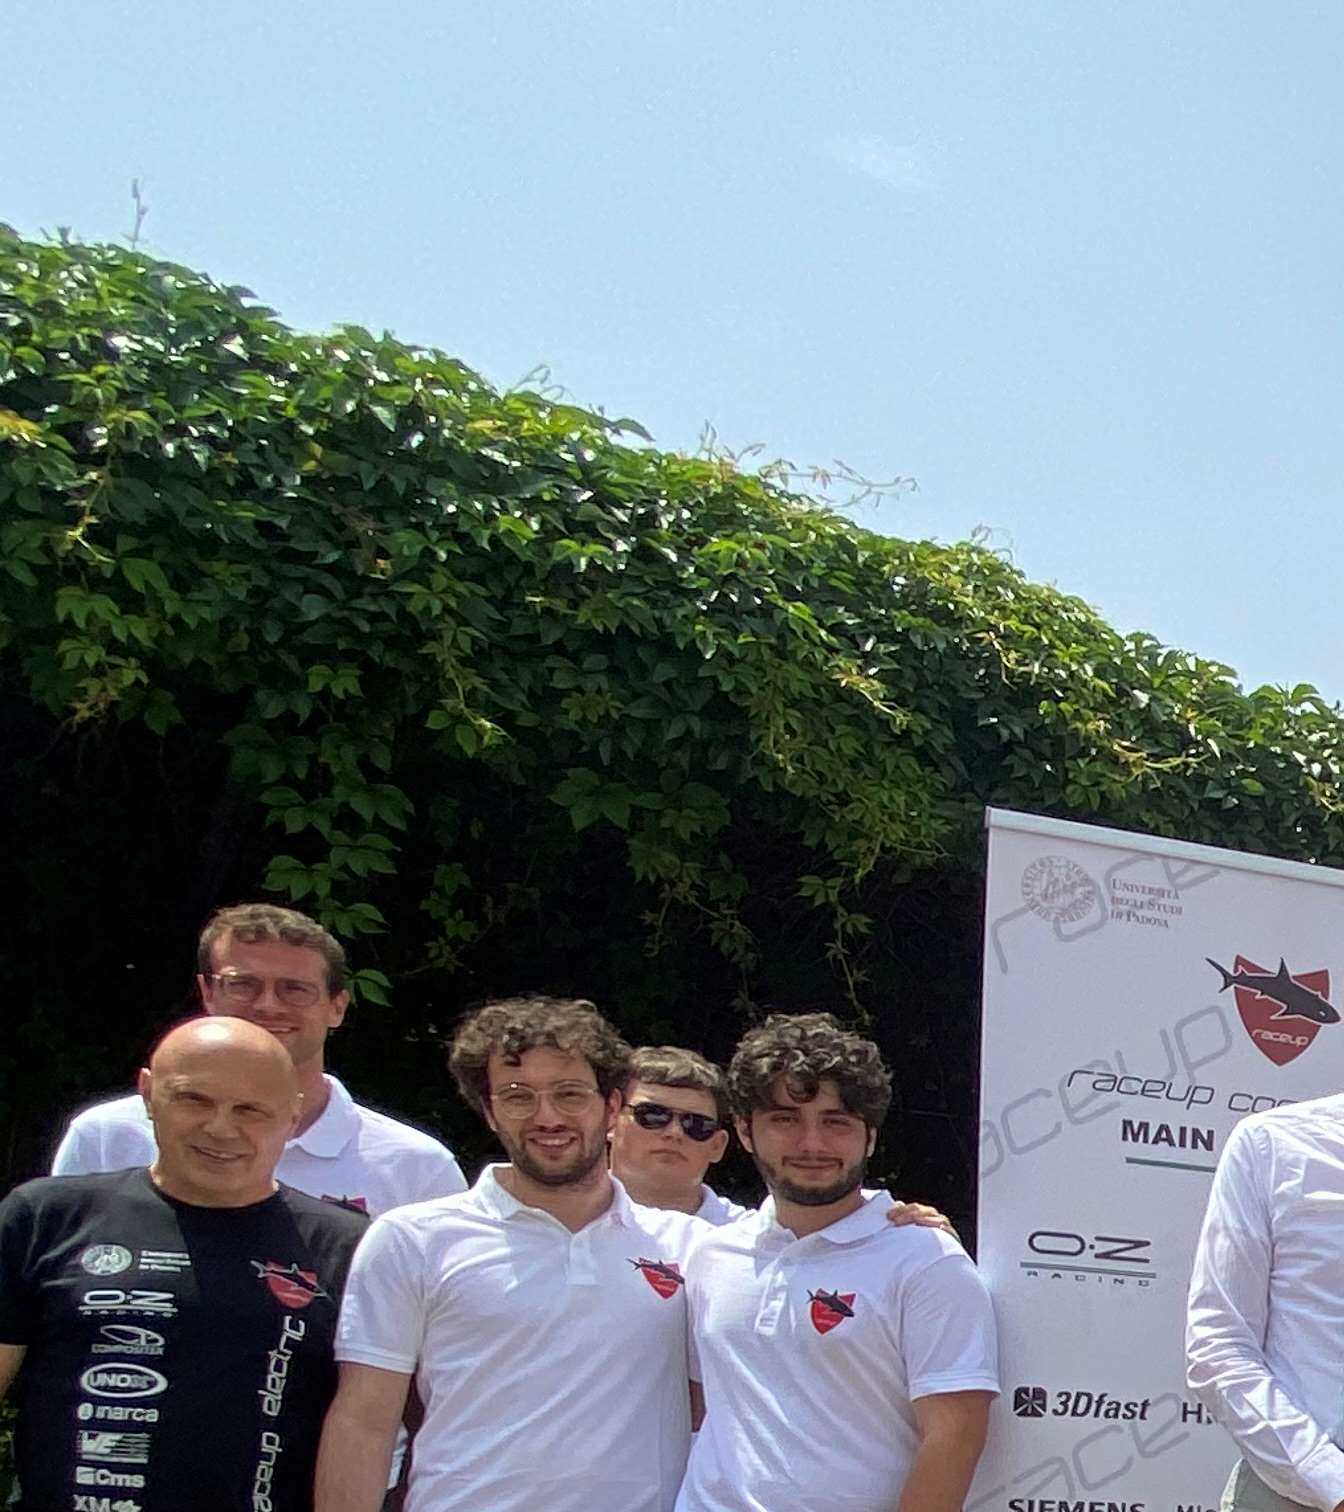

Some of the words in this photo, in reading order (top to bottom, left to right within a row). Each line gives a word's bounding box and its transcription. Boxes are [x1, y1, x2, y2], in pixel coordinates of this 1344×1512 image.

[1066, 1069, 1215, 1110] raceup
[1120, 1118, 1215, 1152] MAIN
[1051, 1390, 1152, 1422] 3Dfast
